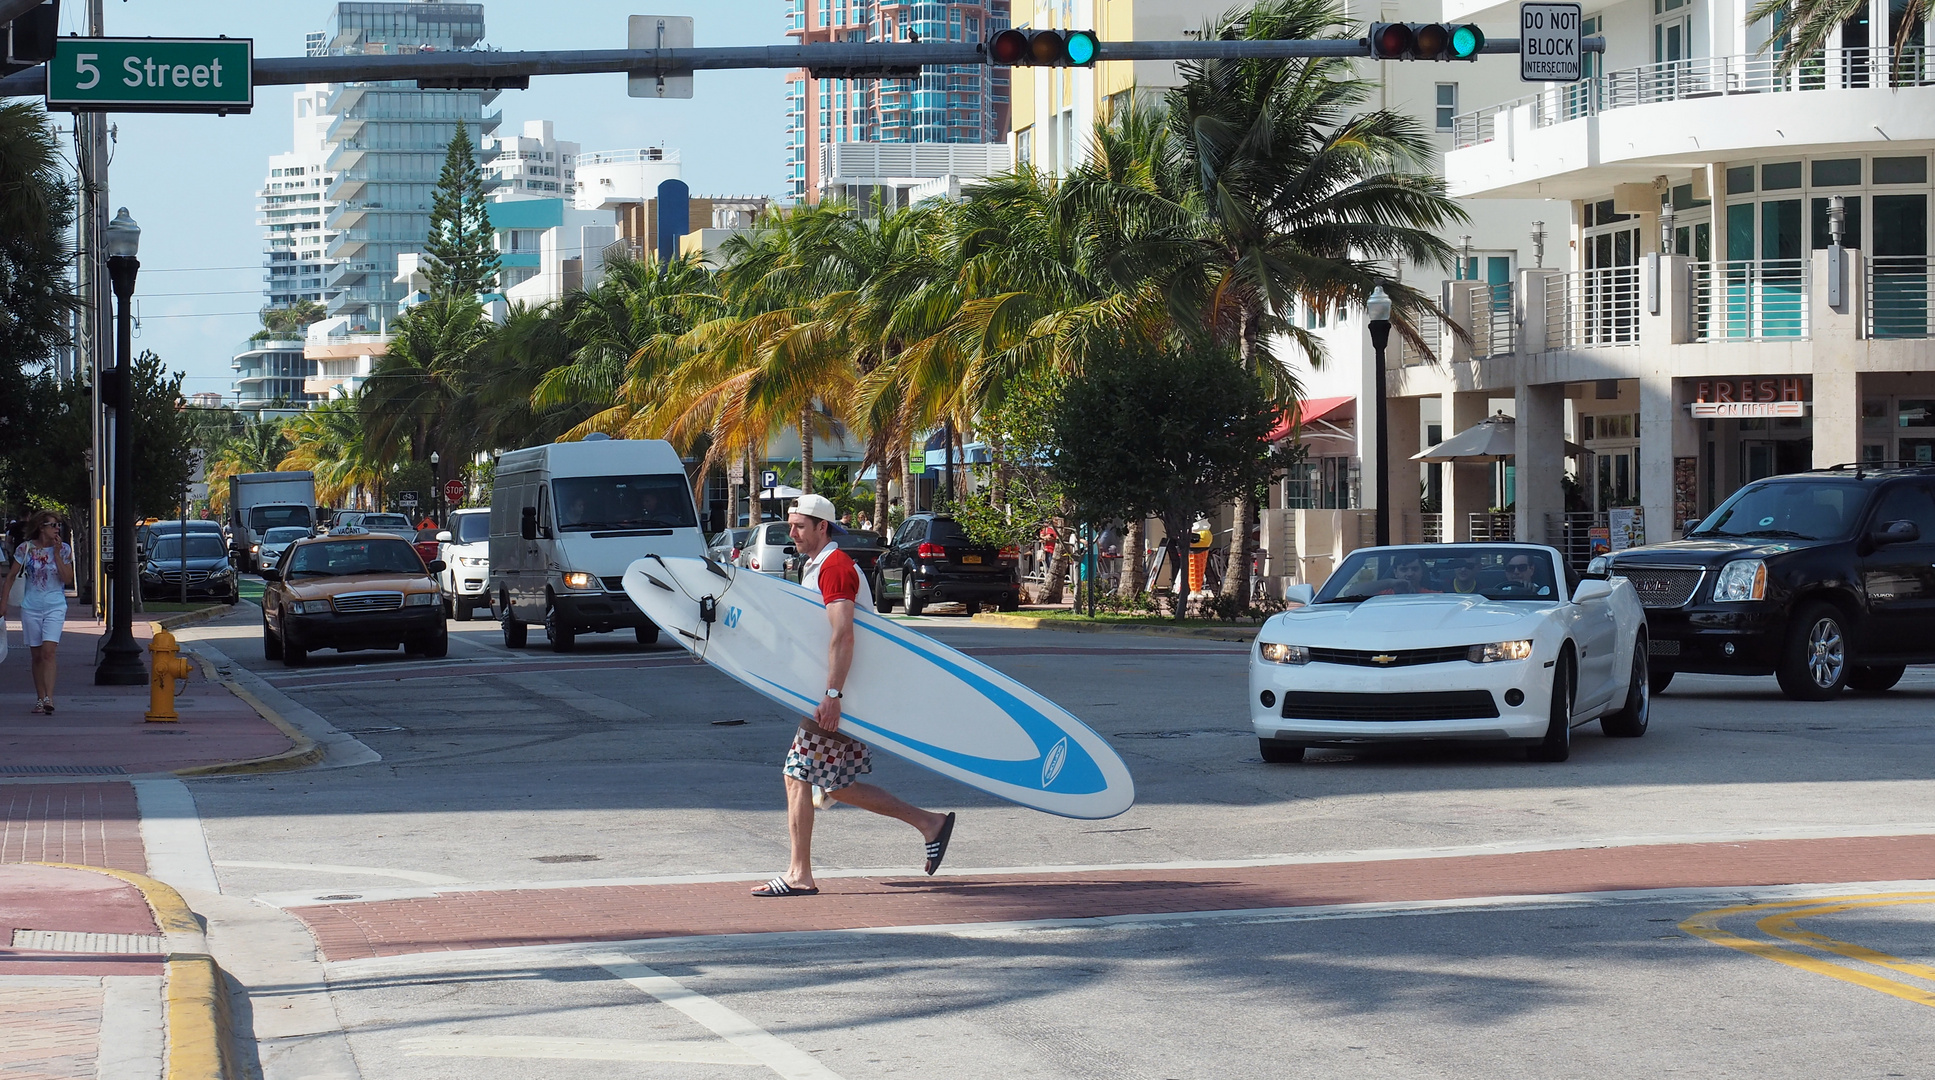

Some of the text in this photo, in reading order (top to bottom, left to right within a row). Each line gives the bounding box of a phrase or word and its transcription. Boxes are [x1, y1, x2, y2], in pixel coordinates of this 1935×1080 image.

[1525, 12, 1577, 29] DO NOT
[1528, 38, 1574, 55] BLOCK
[76, 53, 222, 90] 5 Street
[1525, 61, 1578, 73] INTERSECTION
[1697, 379, 1803, 403] FRESH
[1717, 404, 1776, 416] ON FIFTH
[765, 473, 775, 486] P
[446, 486, 464, 494] STOP
[337, 527, 361, 535] VACANT
[1635, 580, 1671, 592] GMC
